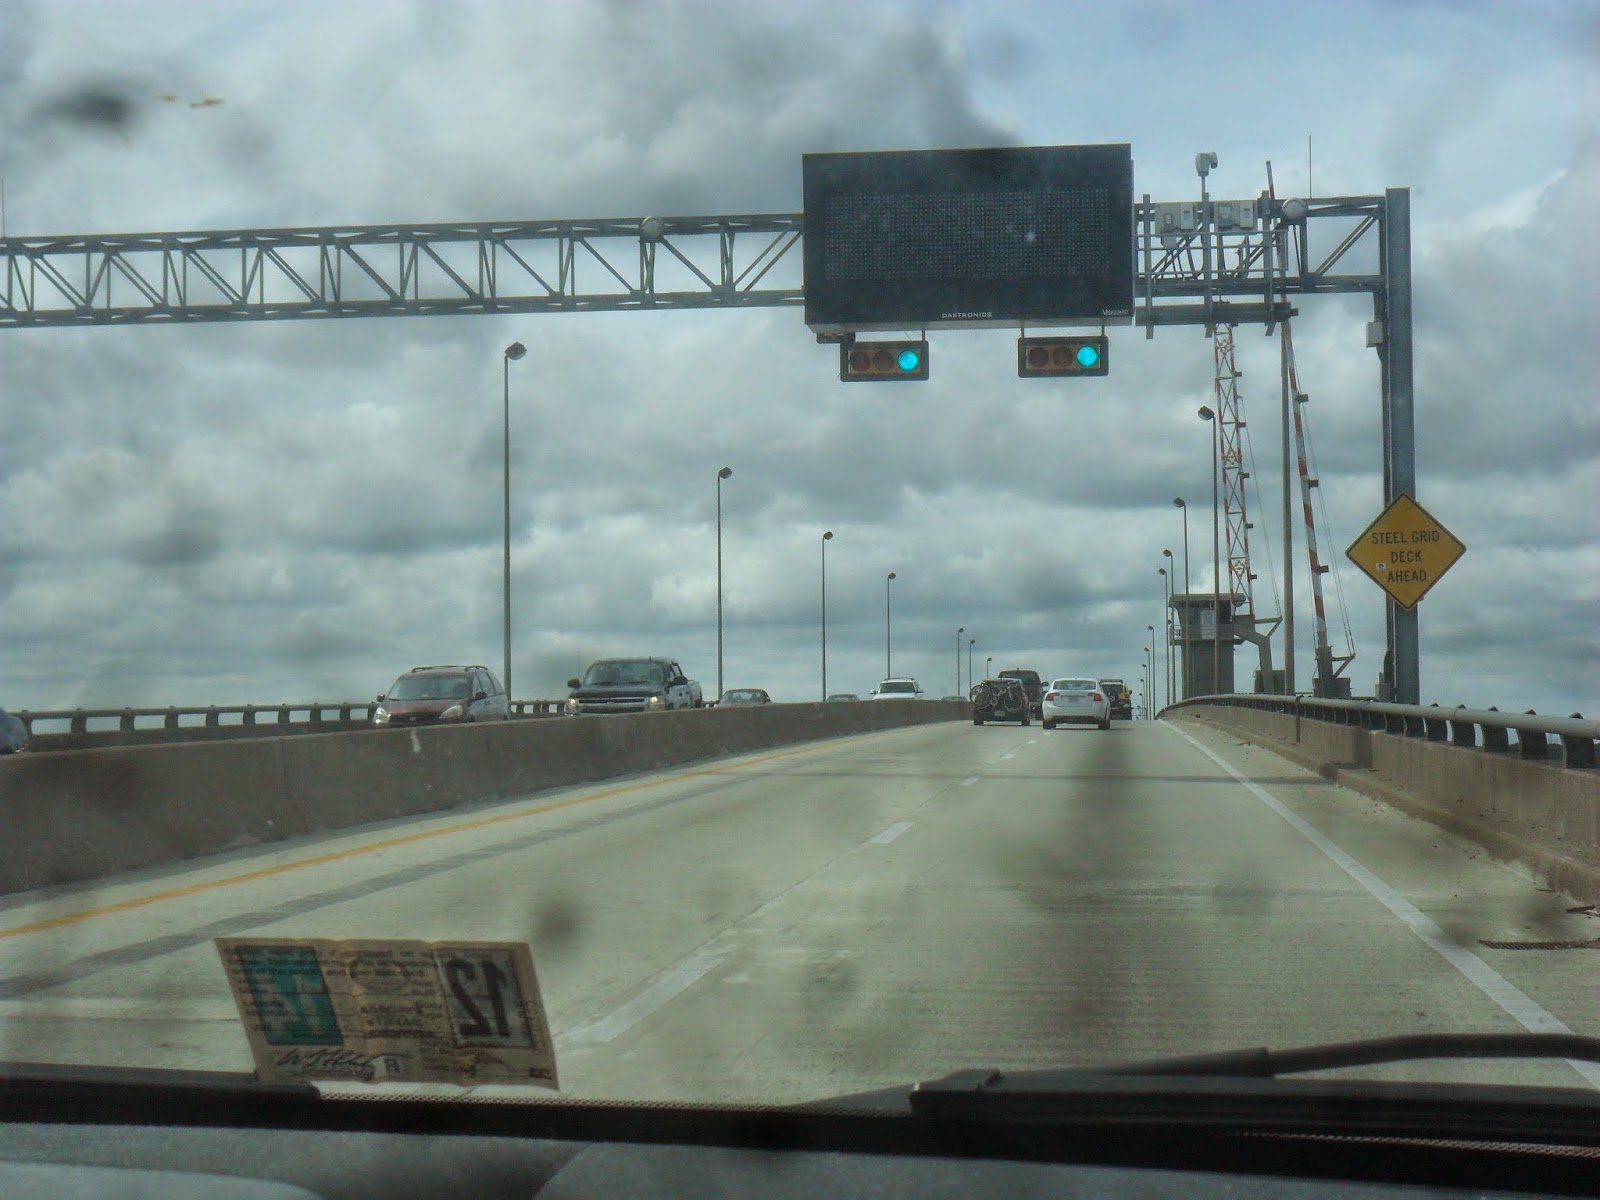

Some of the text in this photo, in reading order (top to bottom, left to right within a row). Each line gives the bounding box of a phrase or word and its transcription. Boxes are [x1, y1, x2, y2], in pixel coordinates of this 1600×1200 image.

[941, 311, 992, 319] DAKTRONICS
[1371, 530, 1440, 545] STEEL GRID
[1390, 550, 1423, 563] DECK
[1387, 569, 1427, 583] AHEAD
